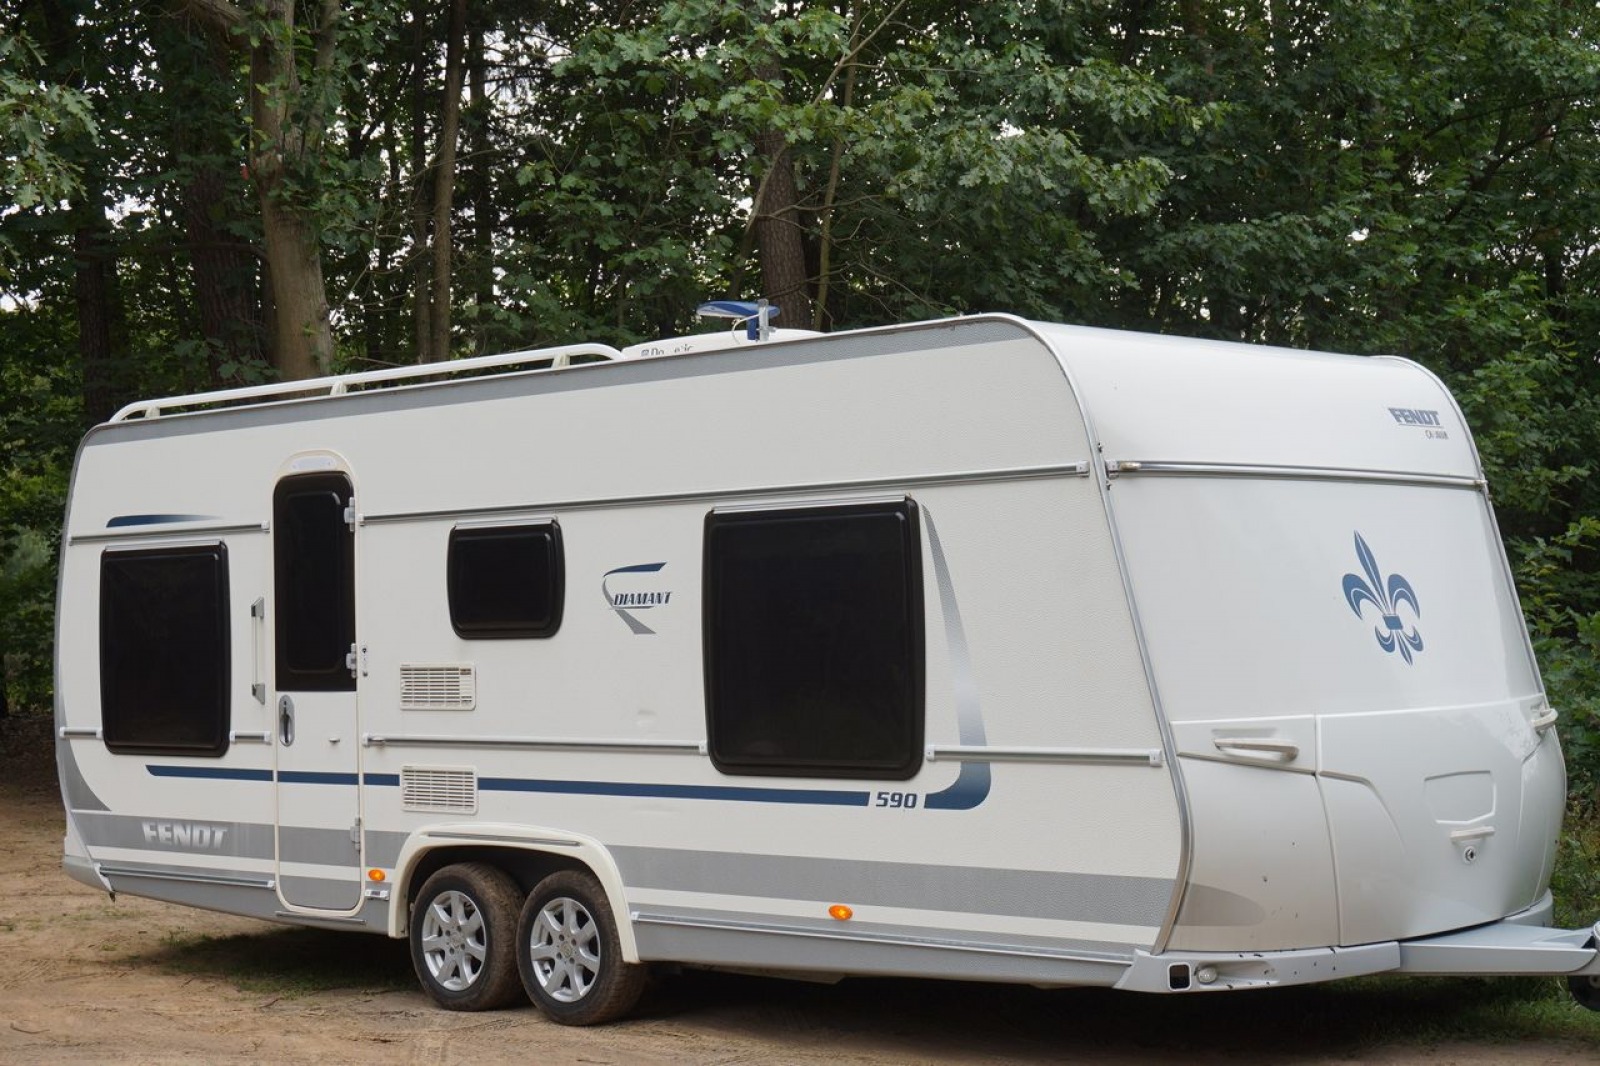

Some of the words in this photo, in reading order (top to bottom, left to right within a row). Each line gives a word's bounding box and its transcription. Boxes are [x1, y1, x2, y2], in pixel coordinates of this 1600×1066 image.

[1388, 407, 1441, 426] FENDT
[614, 591, 672, 605] DIAMANT
[876, 791, 917, 808] 590
[142, 822, 228, 848] FENDT
